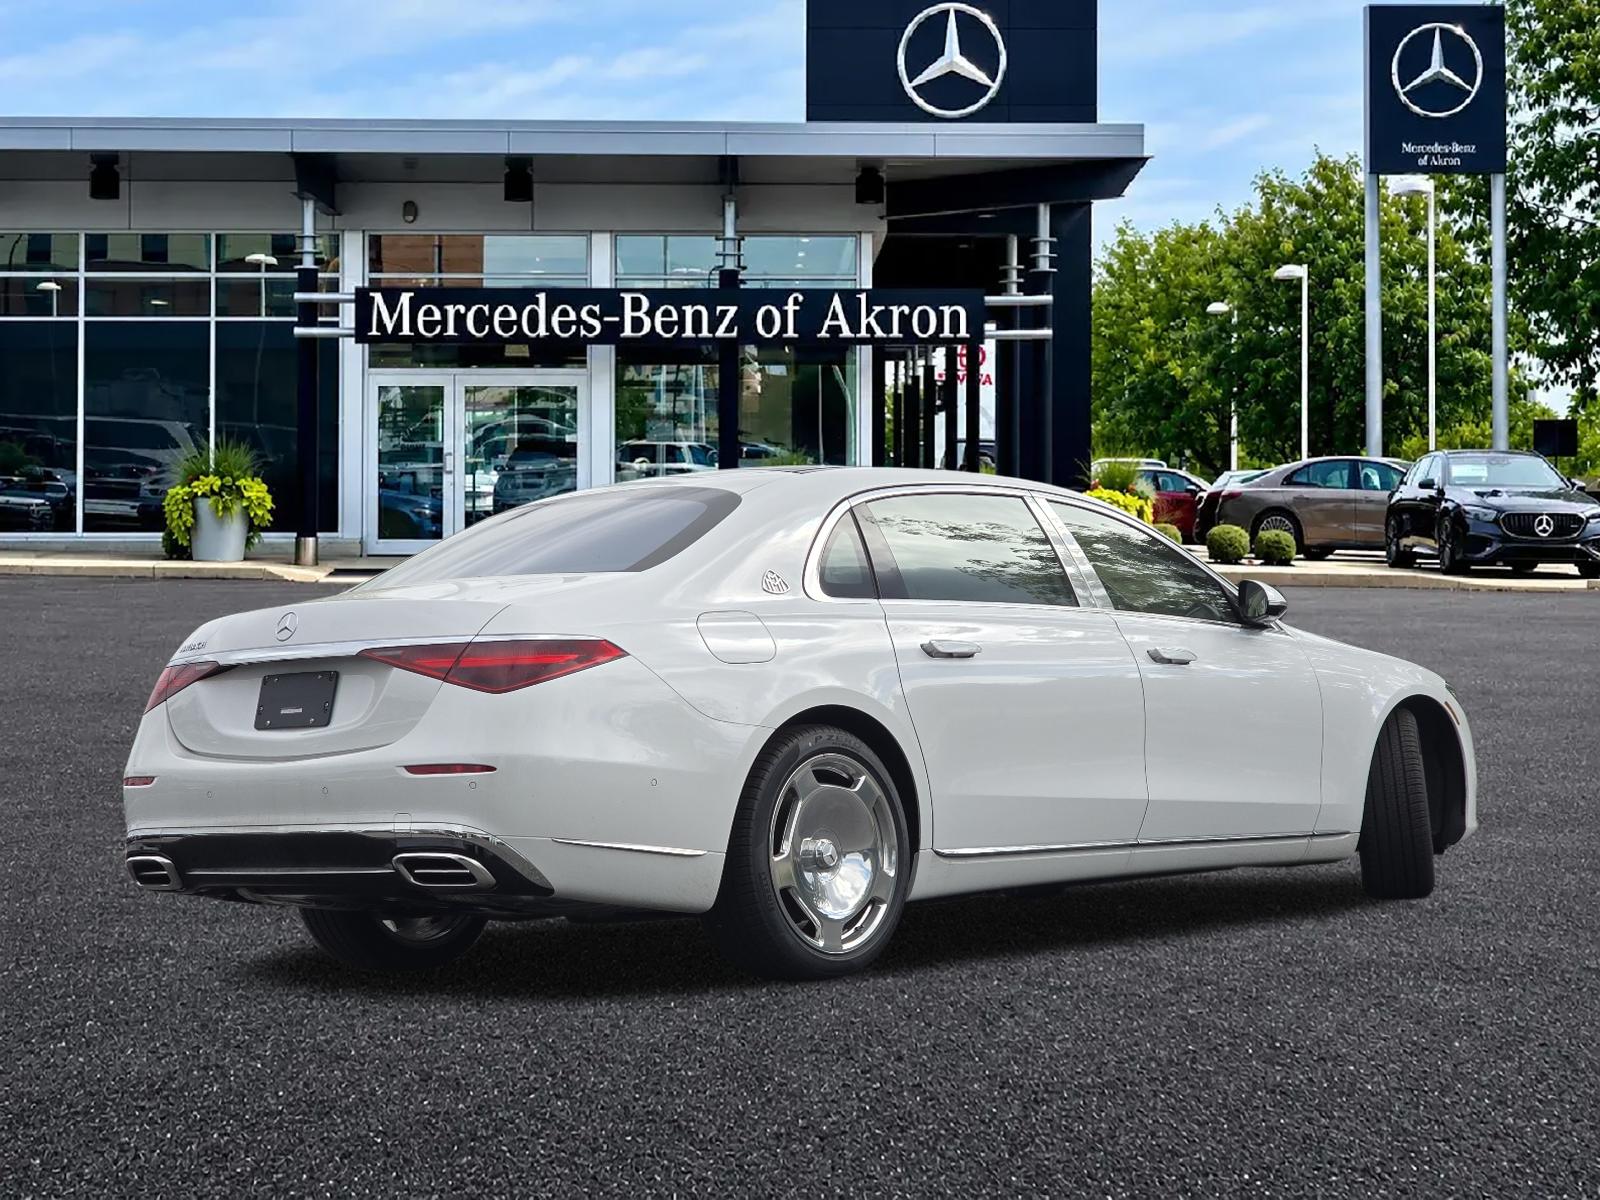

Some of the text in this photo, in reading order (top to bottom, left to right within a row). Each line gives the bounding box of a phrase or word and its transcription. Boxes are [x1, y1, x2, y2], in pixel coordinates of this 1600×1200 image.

[1401, 141, 1476, 154] Mercedes-Benz
[1417, 154, 1461, 166] of Akron
[367, 292, 970, 338] Mercedes-Benz of Akron
